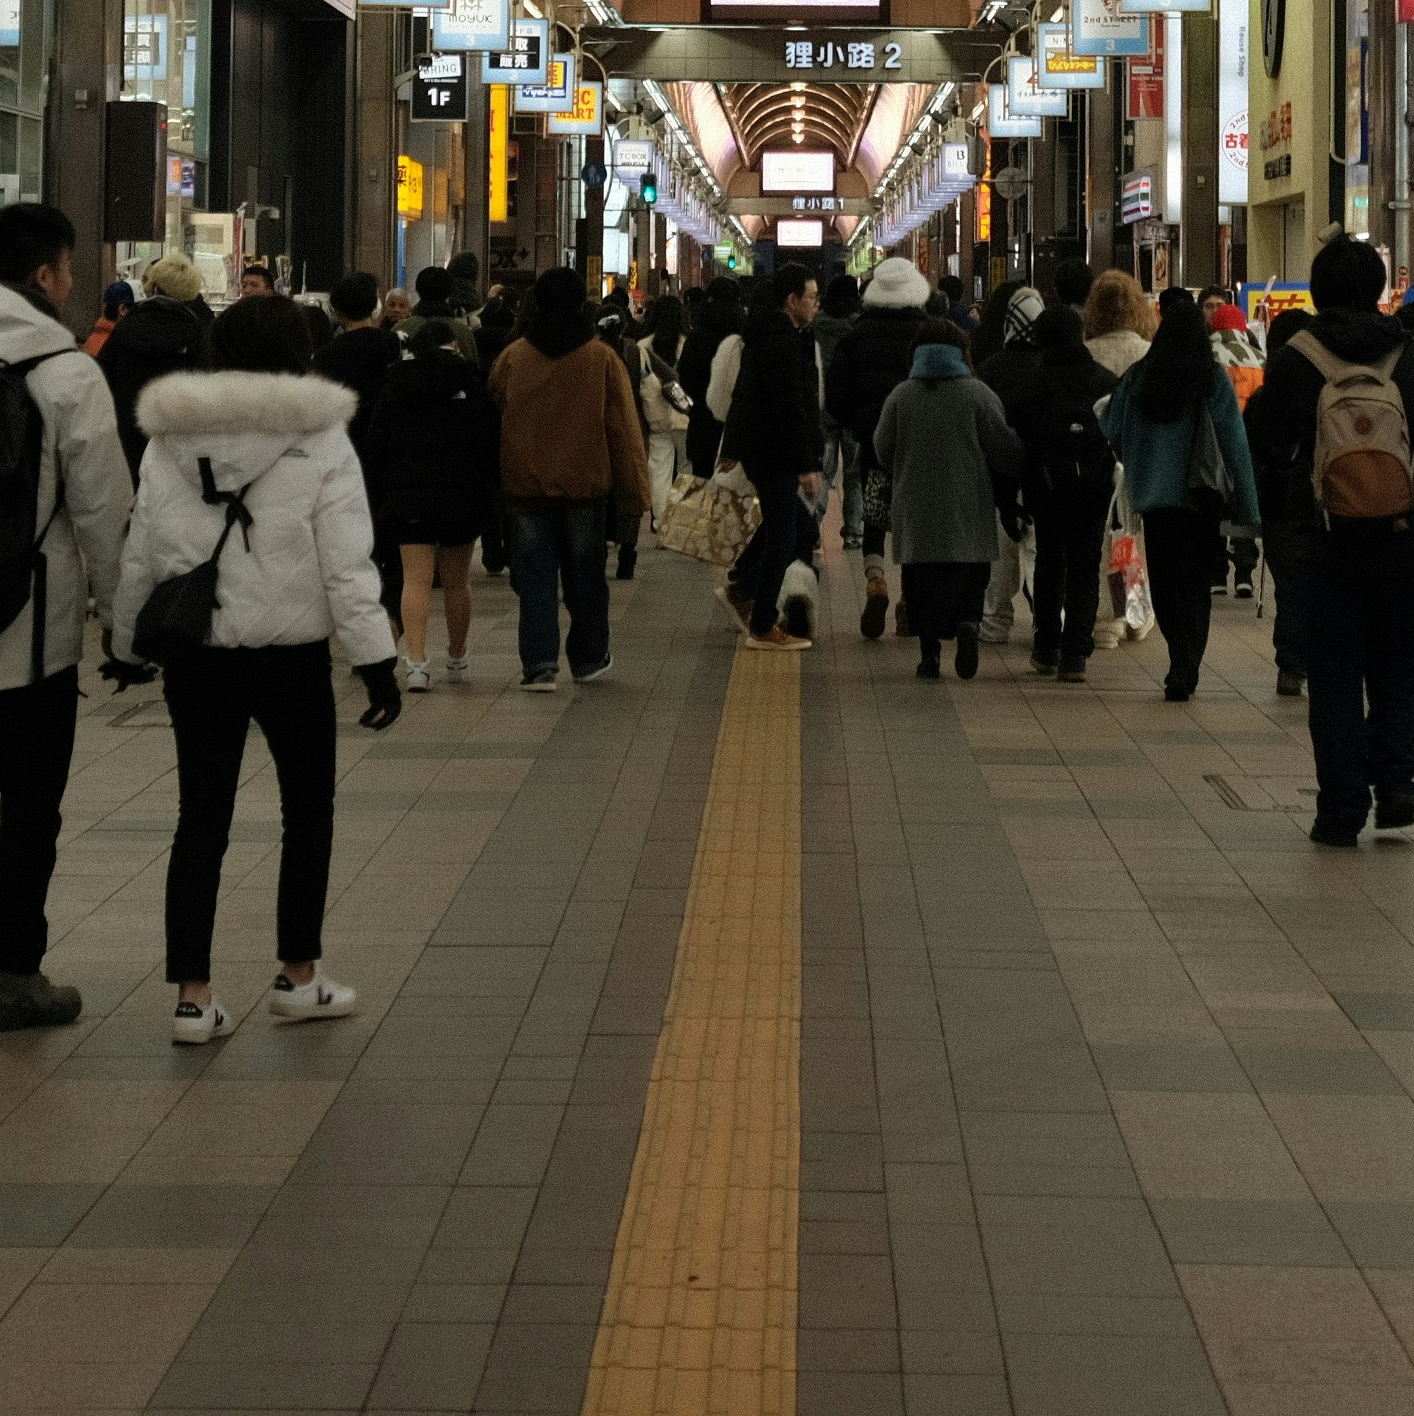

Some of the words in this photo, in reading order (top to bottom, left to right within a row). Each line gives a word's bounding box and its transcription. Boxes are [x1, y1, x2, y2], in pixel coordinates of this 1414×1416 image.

[466, 35, 475, 46] 3
[1105, 40, 1115, 51] 3
[786, 42, 875, 69] 狸小路
[885, 43, 902, 68] 2
[510, 71, 519, 80] 3
[427, 88, 451, 106] 1F
[838, 199, 844, 210] 1
